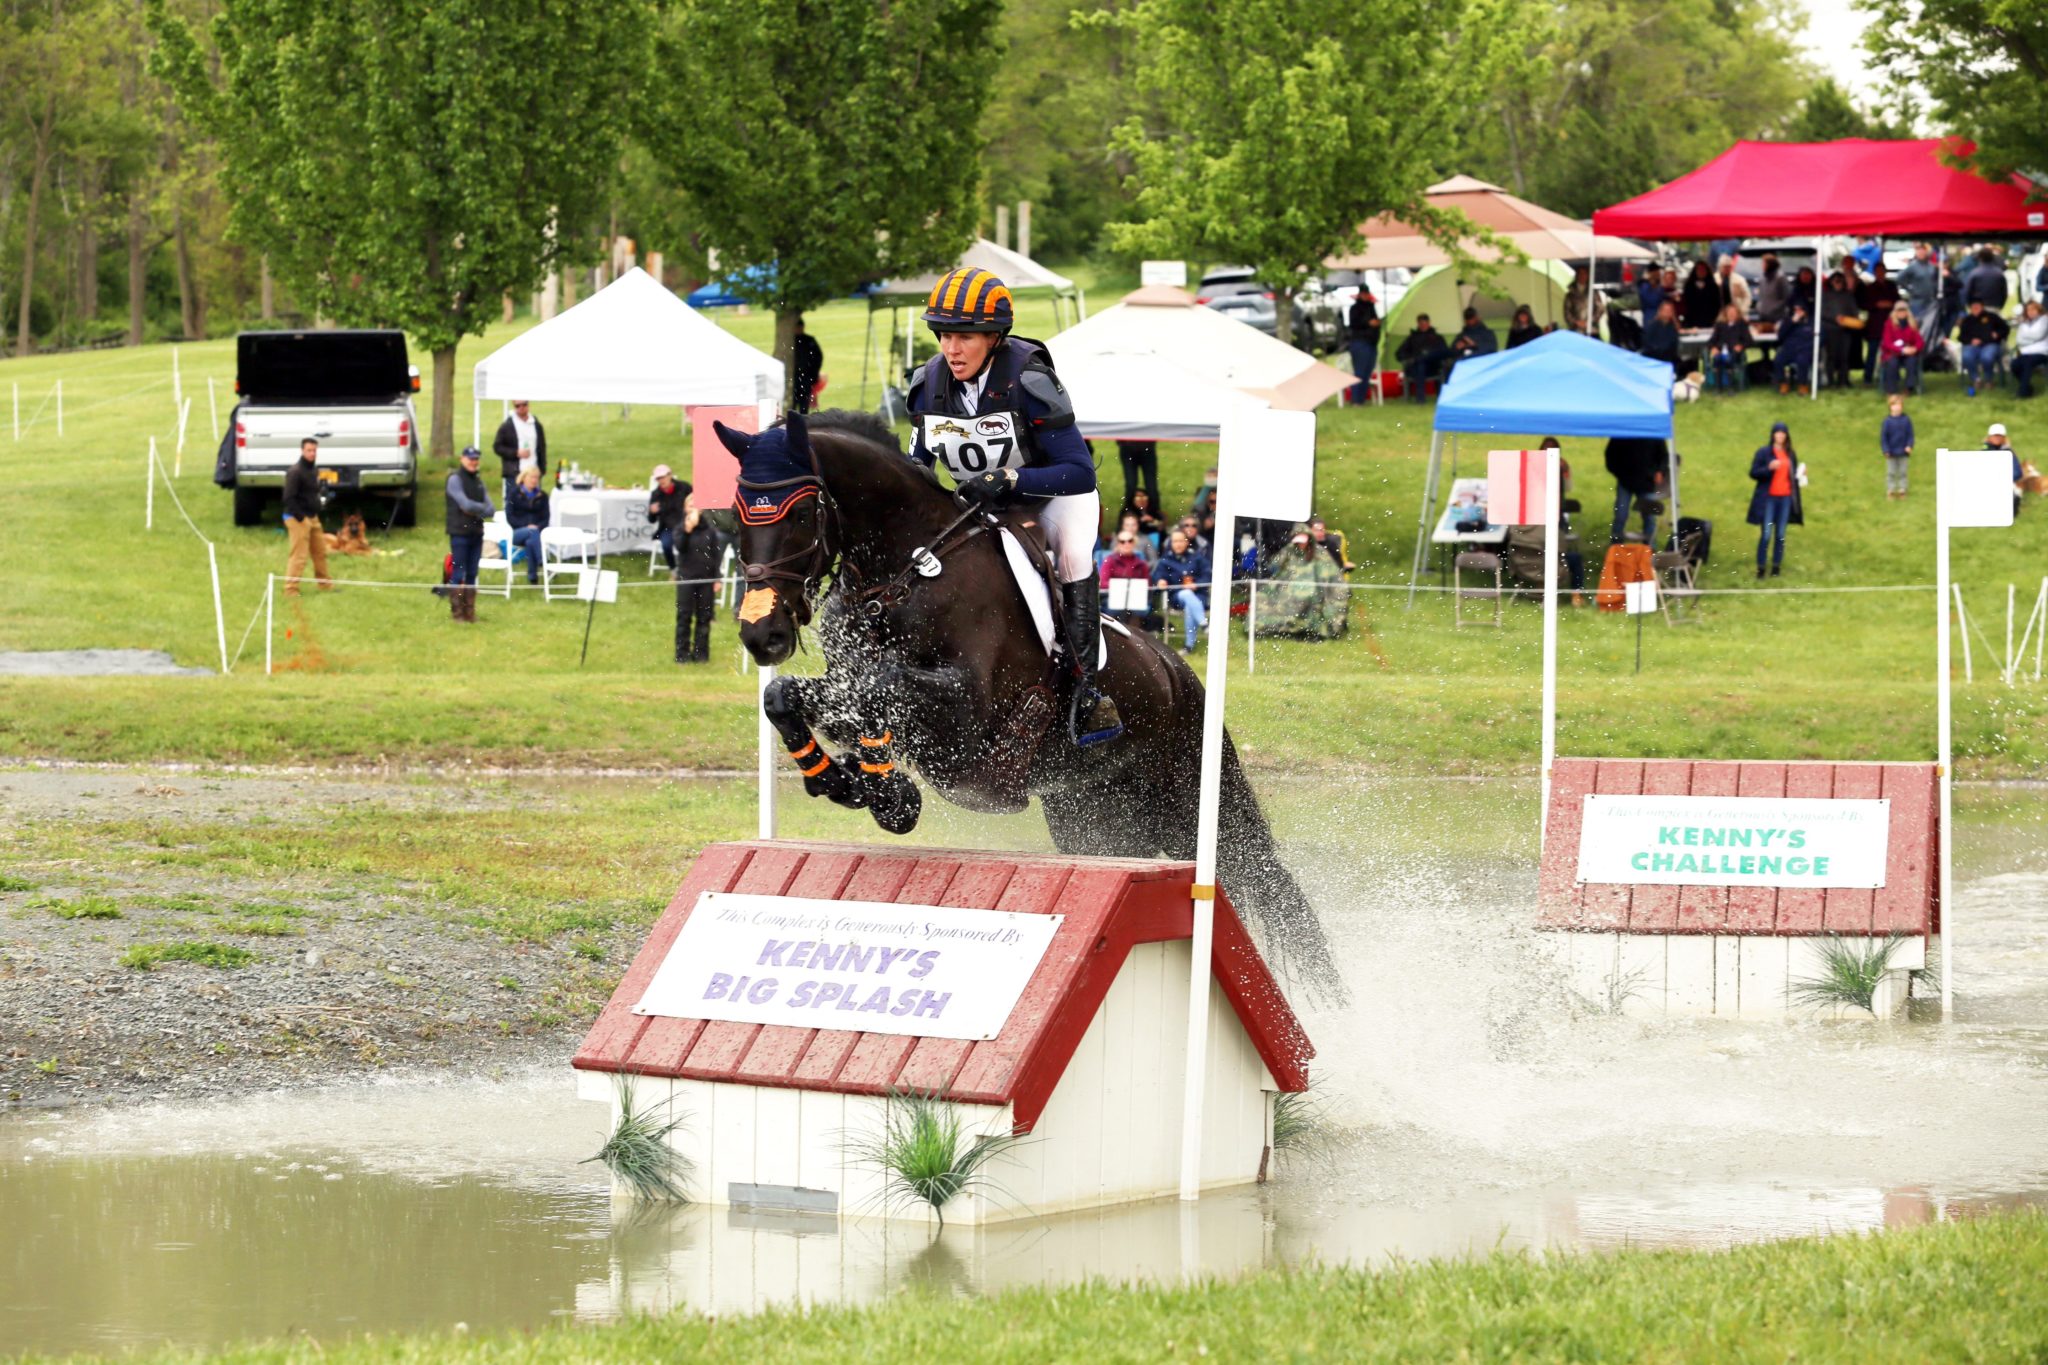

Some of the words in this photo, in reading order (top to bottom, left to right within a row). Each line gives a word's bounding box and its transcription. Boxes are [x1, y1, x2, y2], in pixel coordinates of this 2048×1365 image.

[931, 437, 1014, 472] 107
[1658, 826, 1807, 848] KENNY'S
[1631, 852, 1830, 876] CHALLENGE
[716, 908, 747, 923] This
[752, 910, 818, 930] Complex
[817, 914, 830, 931] is
[835, 916, 919, 939] Generously
[920, 921, 1004, 943] Sponsored
[1001, 928, 1025, 946] By
[756, 939, 941, 978] KENNY'S
[702, 972, 779, 1005] BIG
[786, 980, 953, 1019] SPLASH
